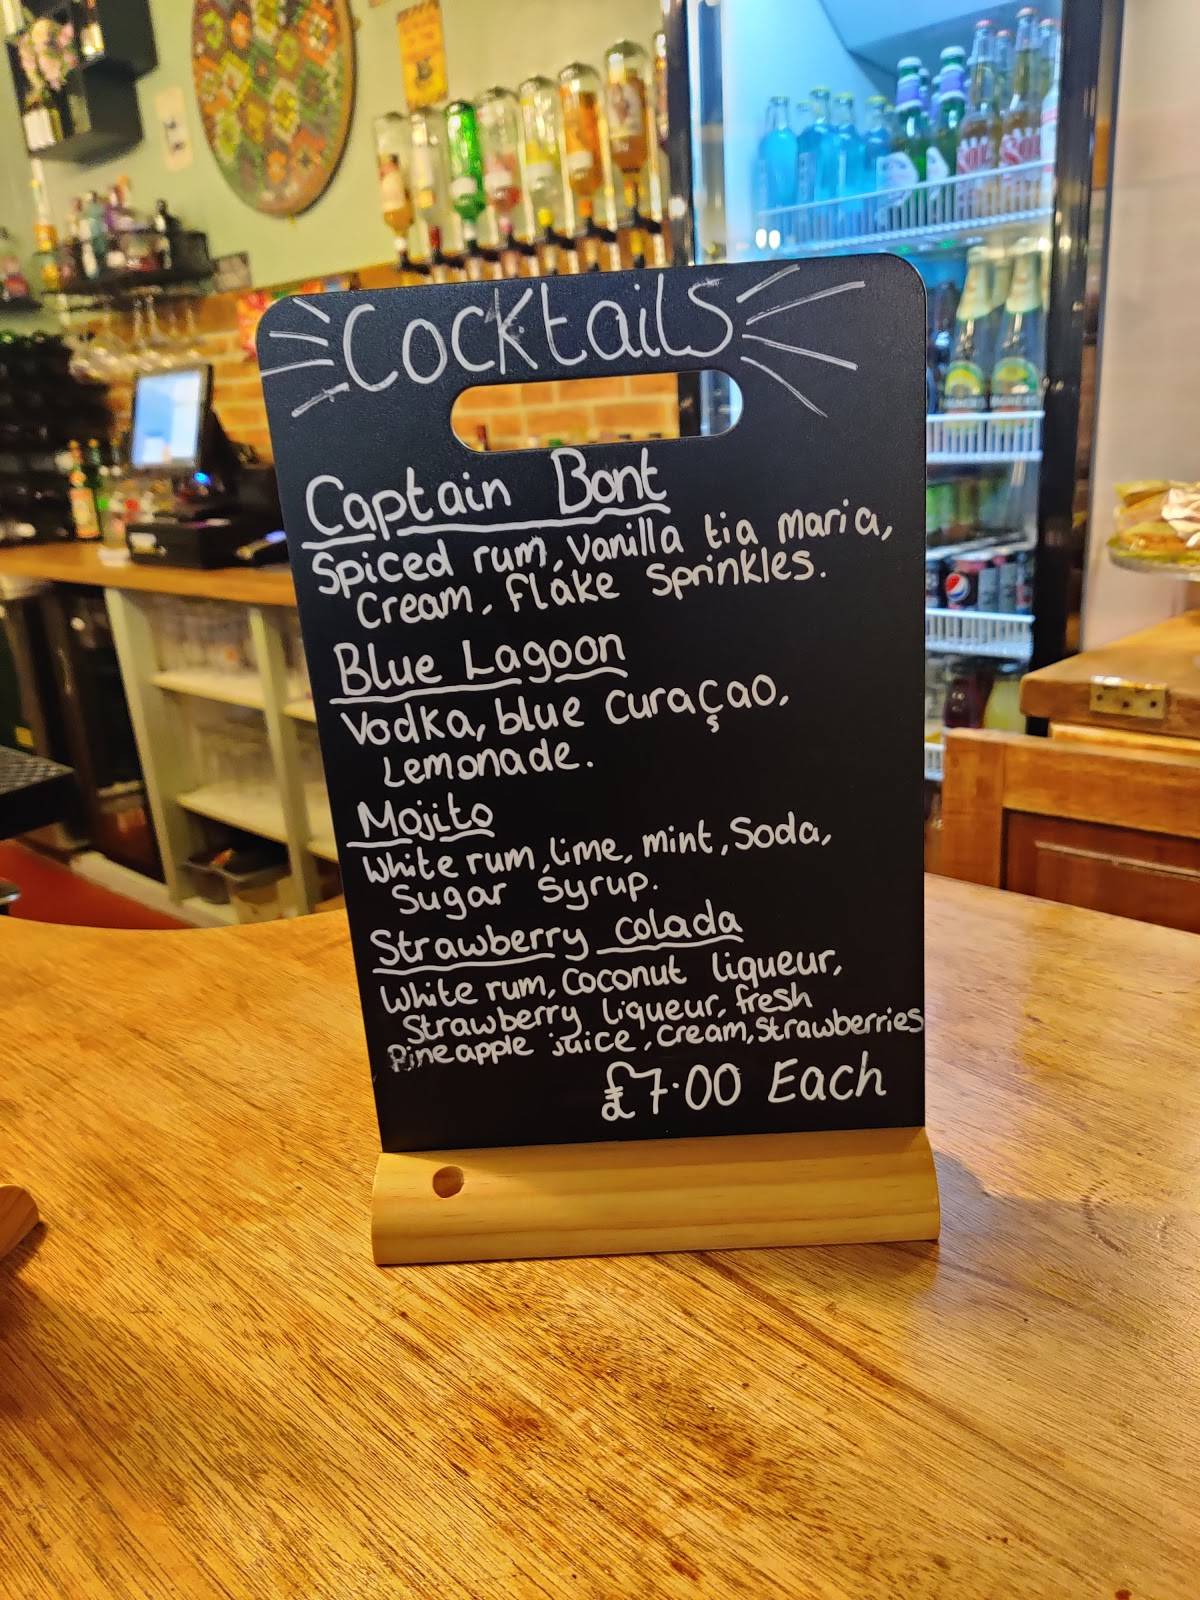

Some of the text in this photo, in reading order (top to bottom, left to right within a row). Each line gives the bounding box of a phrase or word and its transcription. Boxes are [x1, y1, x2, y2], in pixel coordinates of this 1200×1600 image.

[305, 447, 667, 541] Captain Bont
[311, 538, 454, 600] Spiced
[704, 511, 758, 550] tia
[505, 570, 620, 613] flake
[334, 633, 625, 696] Blue Lagoon
[494, 695, 585, 736] blue
[356, 792, 494, 842] Mojito
[369, 924, 590, 966] Strawberry
[711, 949, 842, 989] liqueur,
[735, 982, 813, 1015] fresh
[767, 1050, 888, 1104] Each
